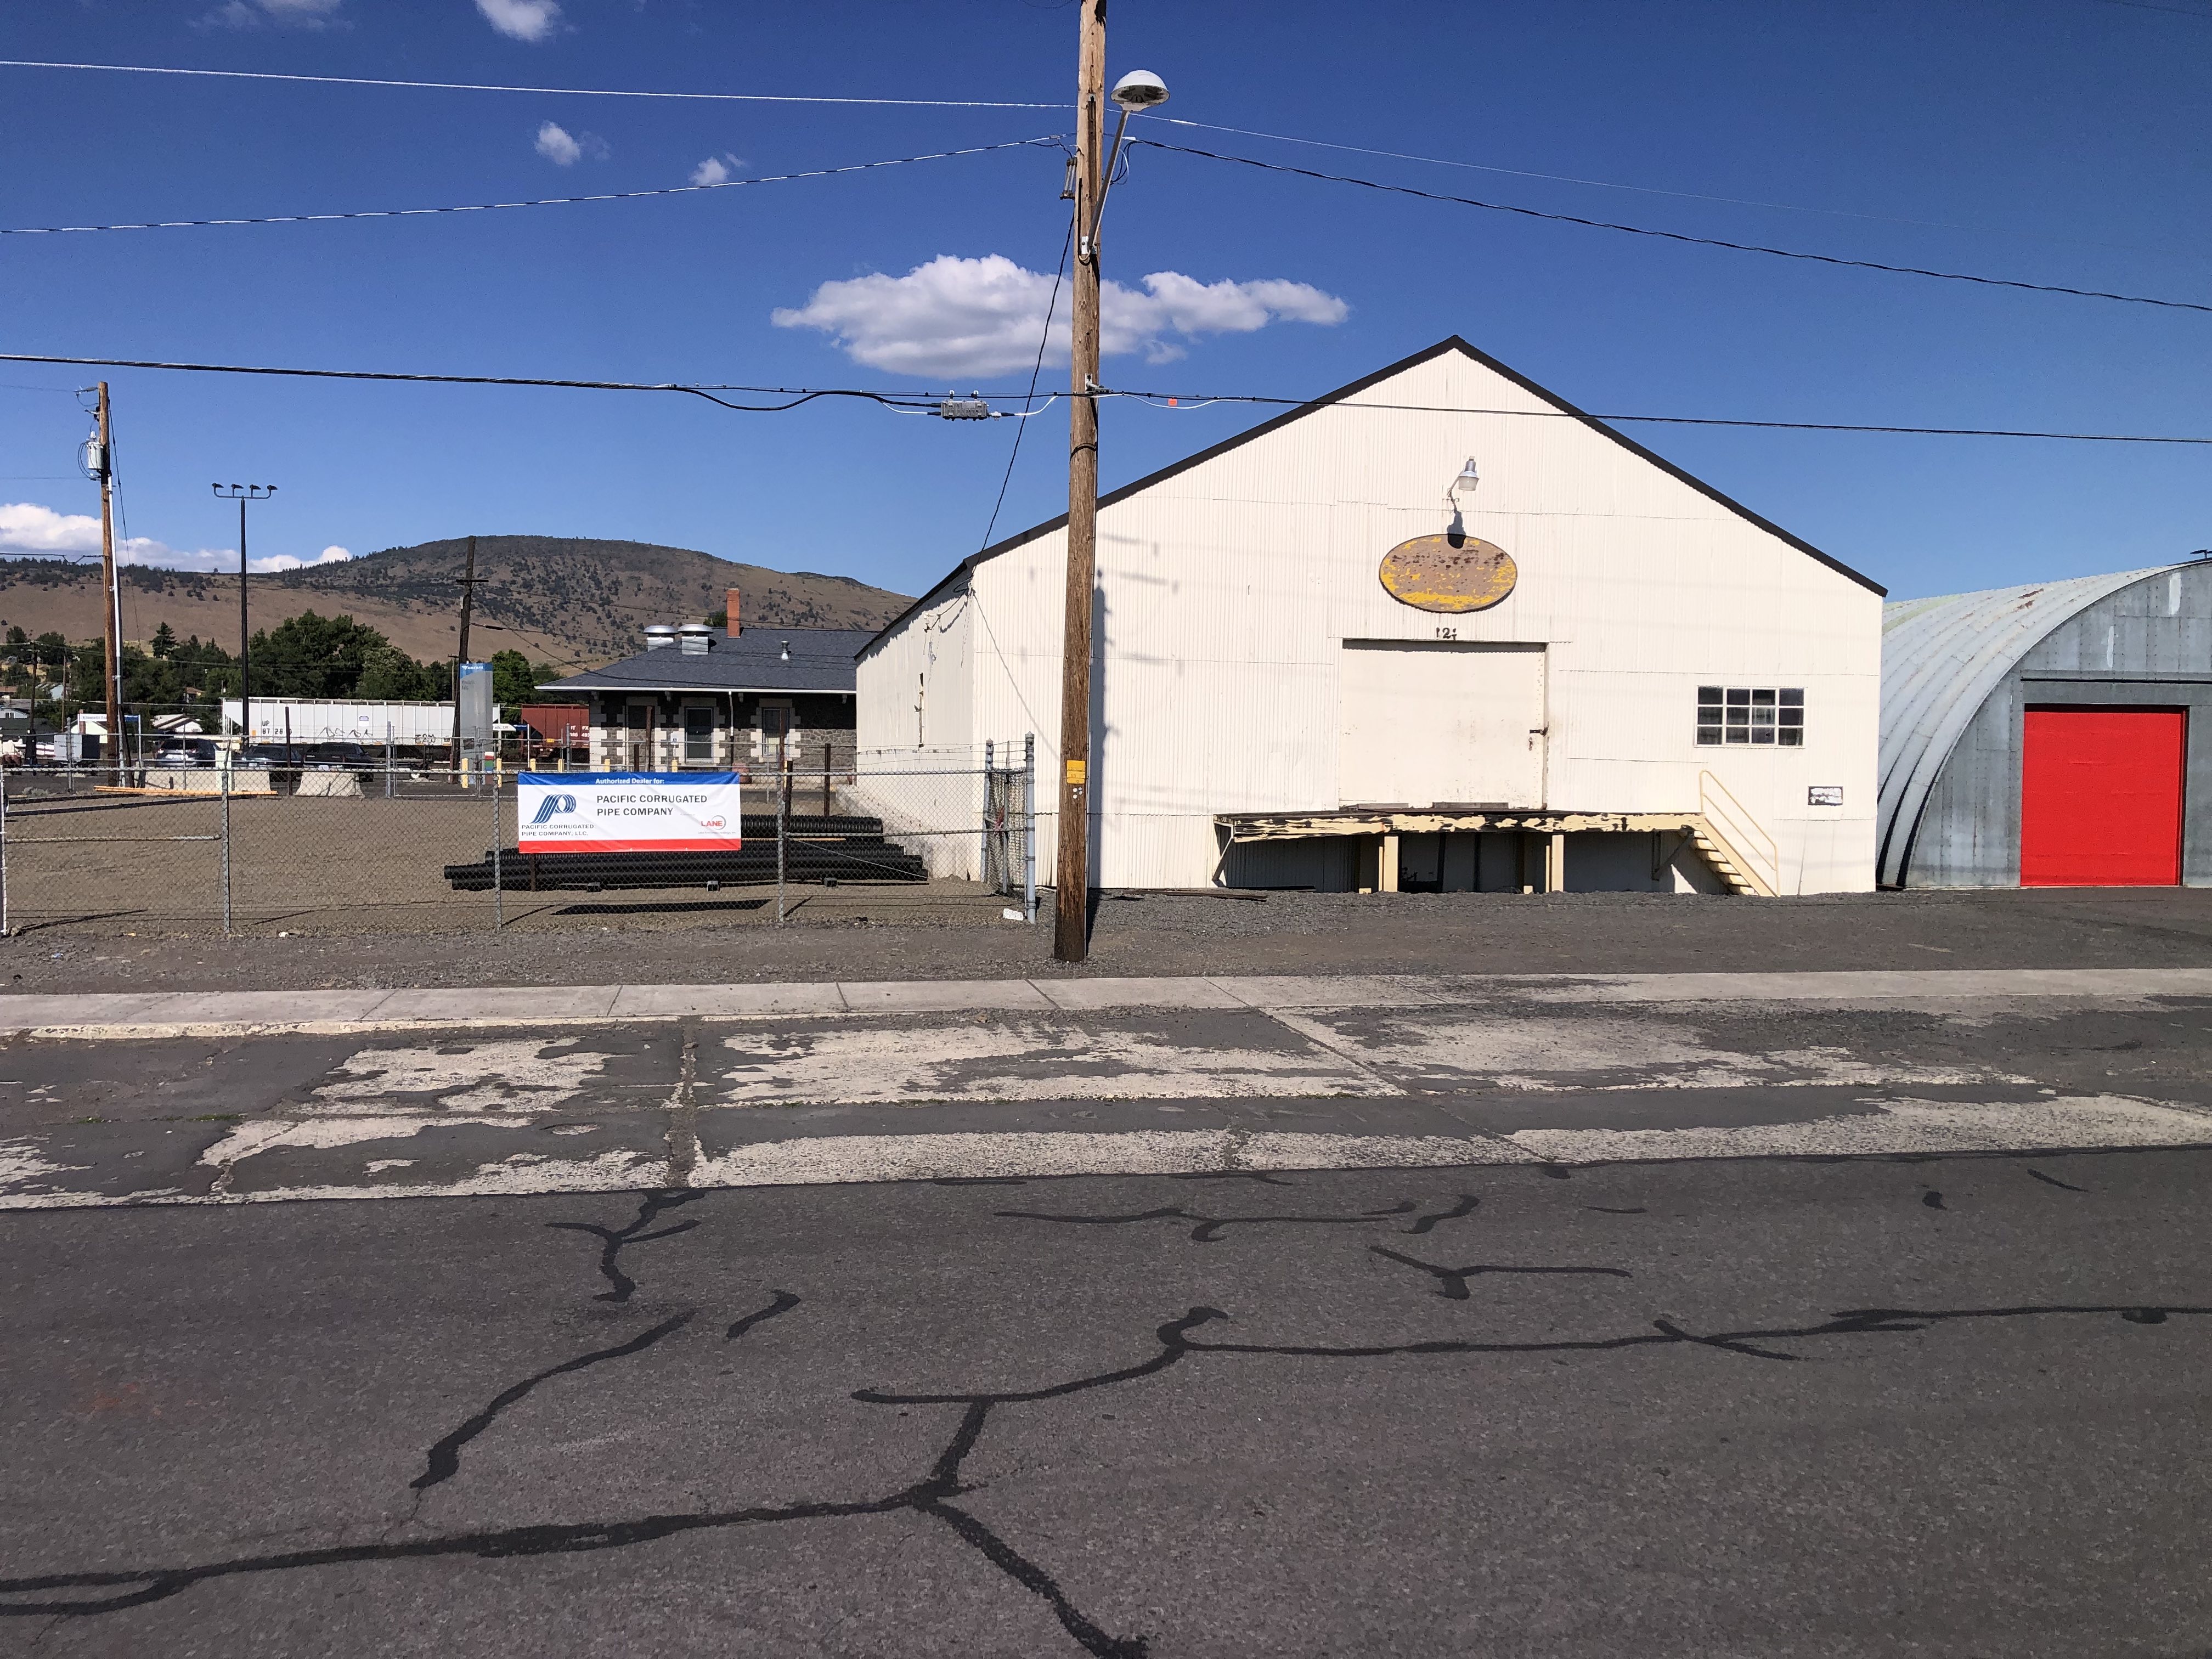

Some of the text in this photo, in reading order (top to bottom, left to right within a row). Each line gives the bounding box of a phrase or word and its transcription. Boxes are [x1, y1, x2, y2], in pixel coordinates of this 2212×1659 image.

[597, 795, 707, 803] PACIFIC CORRUGATED
[623, 808, 673, 816] COMPANY
